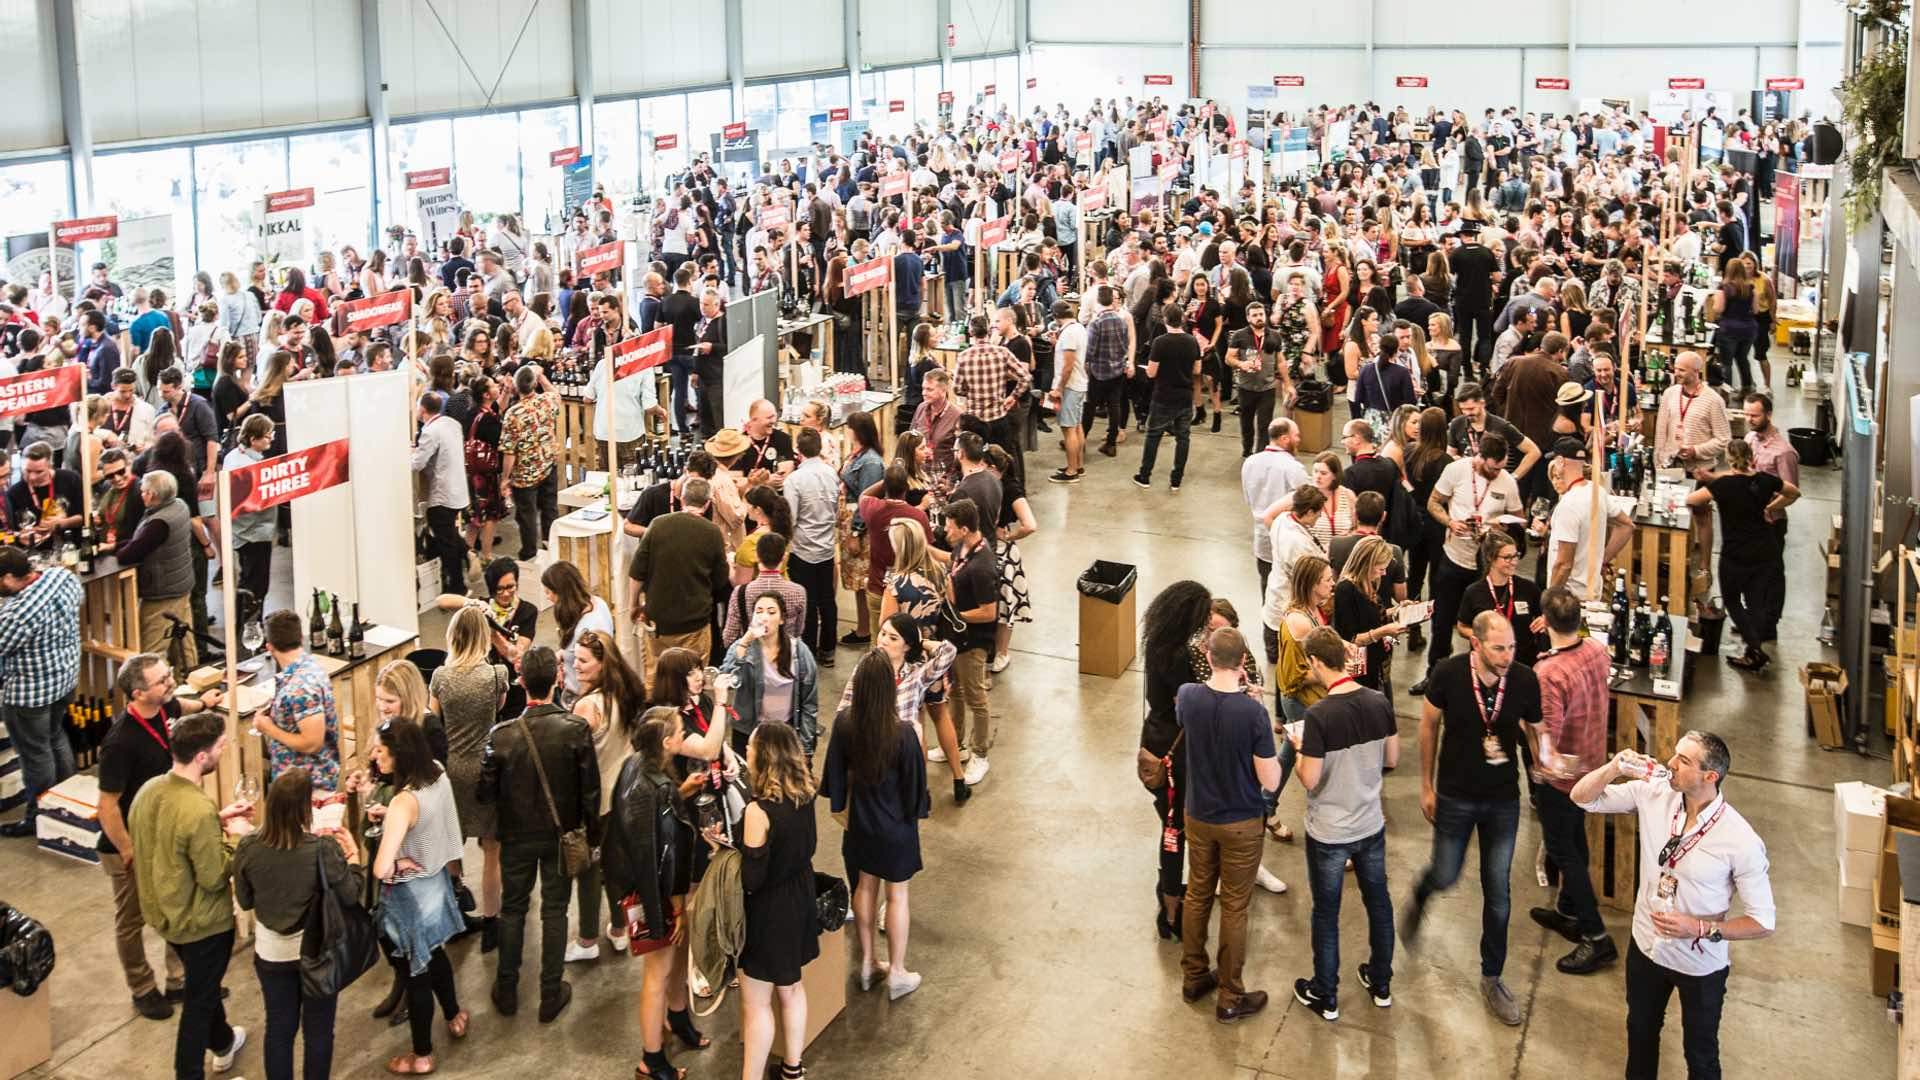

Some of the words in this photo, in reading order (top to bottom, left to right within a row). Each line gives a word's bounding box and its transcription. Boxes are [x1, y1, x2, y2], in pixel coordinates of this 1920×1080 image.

[56, 225, 83, 237] GIANT
[86, 222, 112, 233] STEPS
[346, 300, 402, 322] SHADOWFAX
[0, 375, 56, 397] ASTERN
[260, 456, 308, 483] DIRTY
[257, 472, 311, 500] THREE
